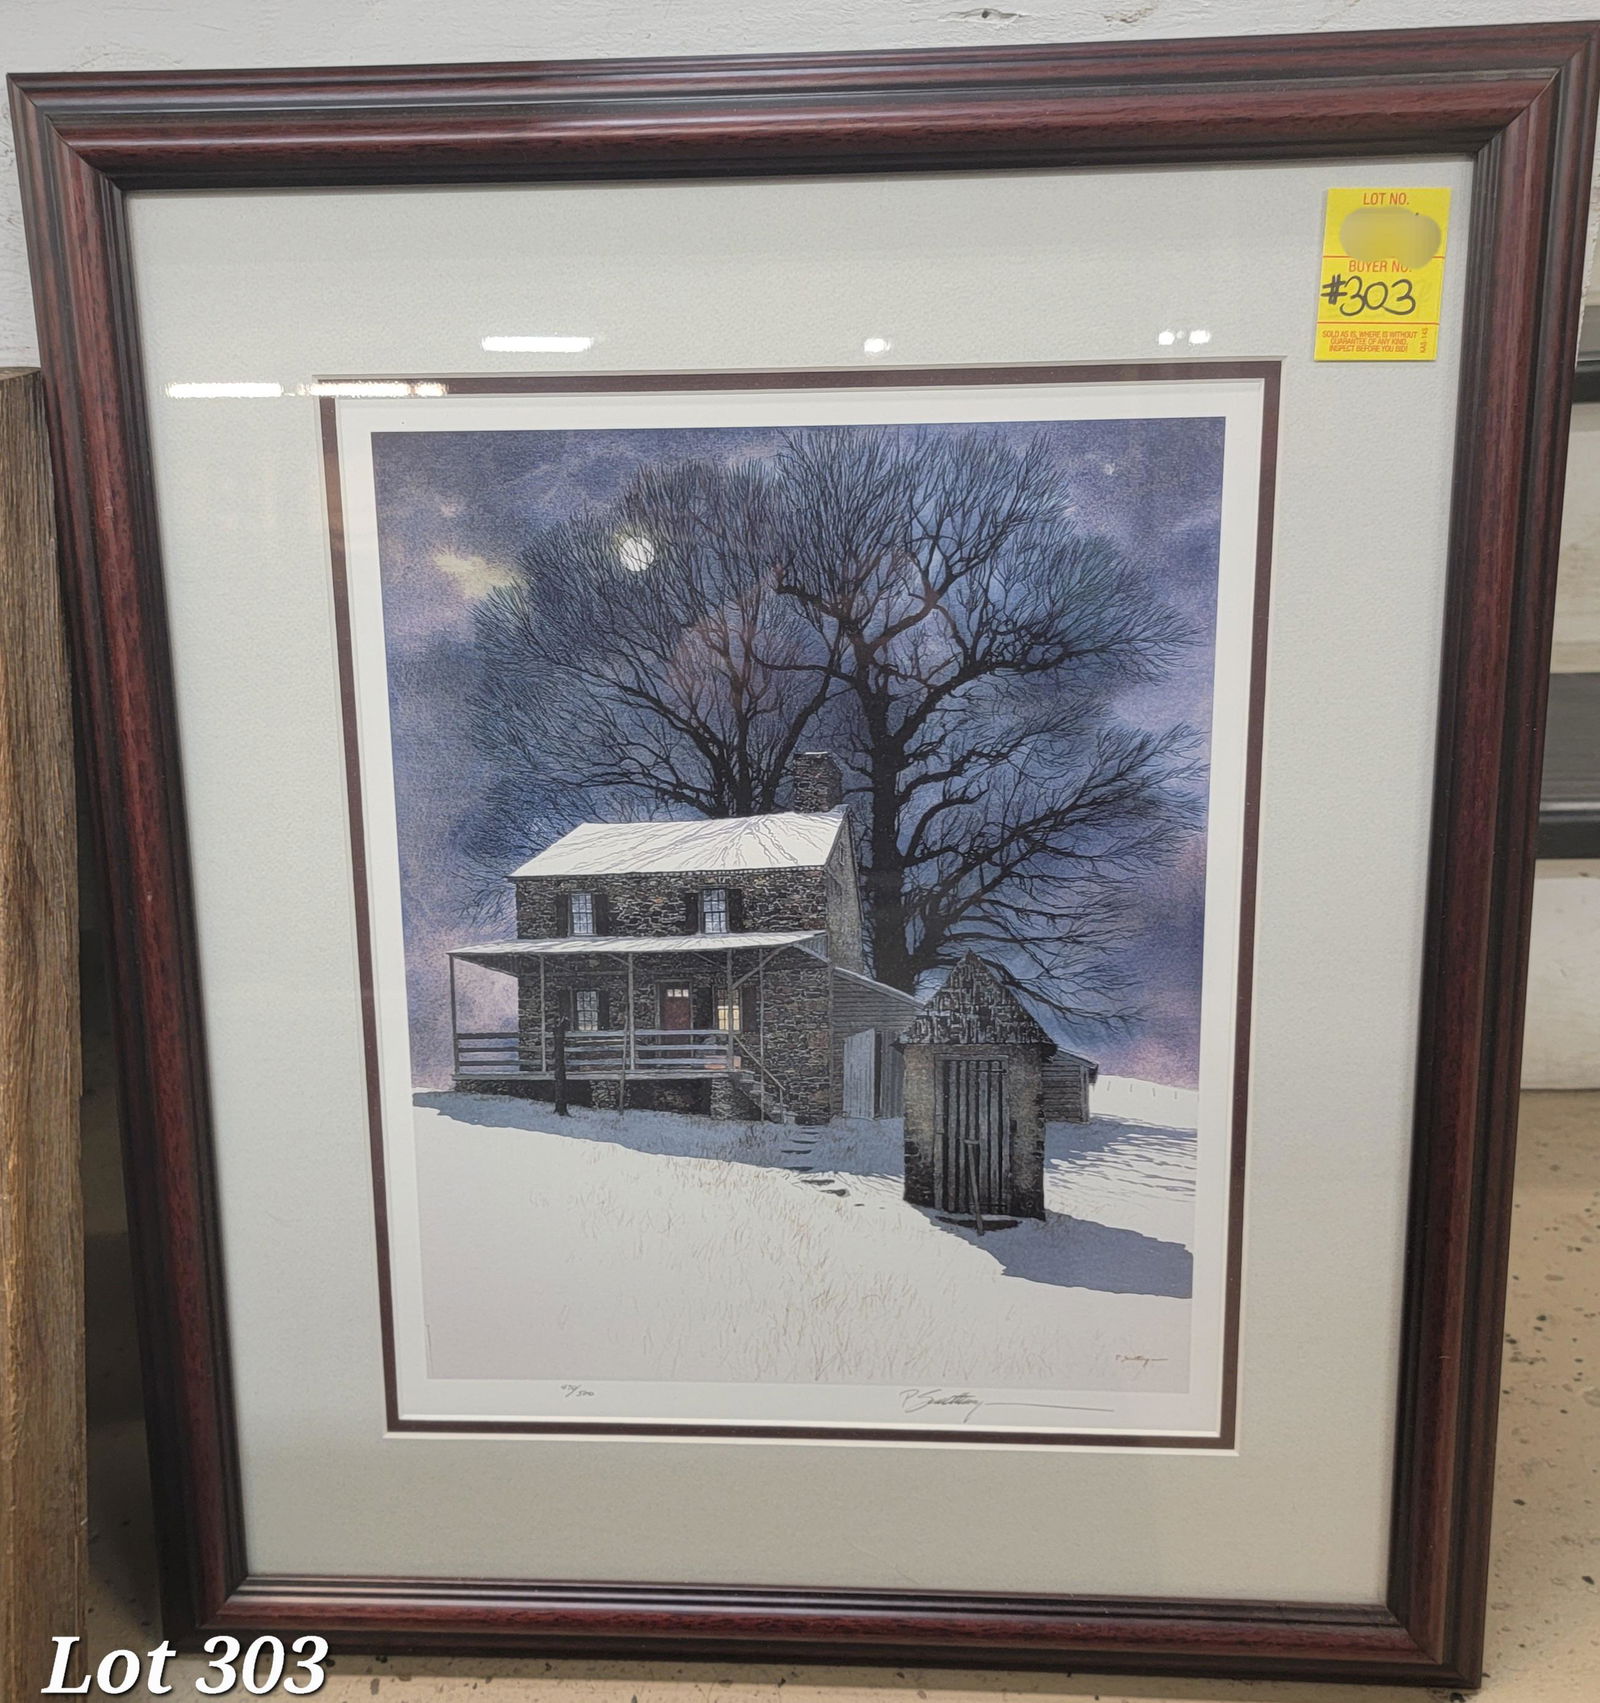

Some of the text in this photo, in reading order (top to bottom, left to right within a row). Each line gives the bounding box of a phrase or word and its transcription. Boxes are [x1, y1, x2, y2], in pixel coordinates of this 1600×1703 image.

[1363, 192, 1410, 206] LOT NO.
[1349, 259, 1388, 273] BUYER
[1320, 273, 1417, 317] #303
[1322, 330, 1340, 339] SOLD
[1340, 330, 1350, 339] AS
[1389, 331, 1418, 339] WITHOUT
[1329, 345, 1355, 353] INSPECT
[1355, 345, 1380, 353] BEFORE
[1381, 345, 1394, 353] YOU
